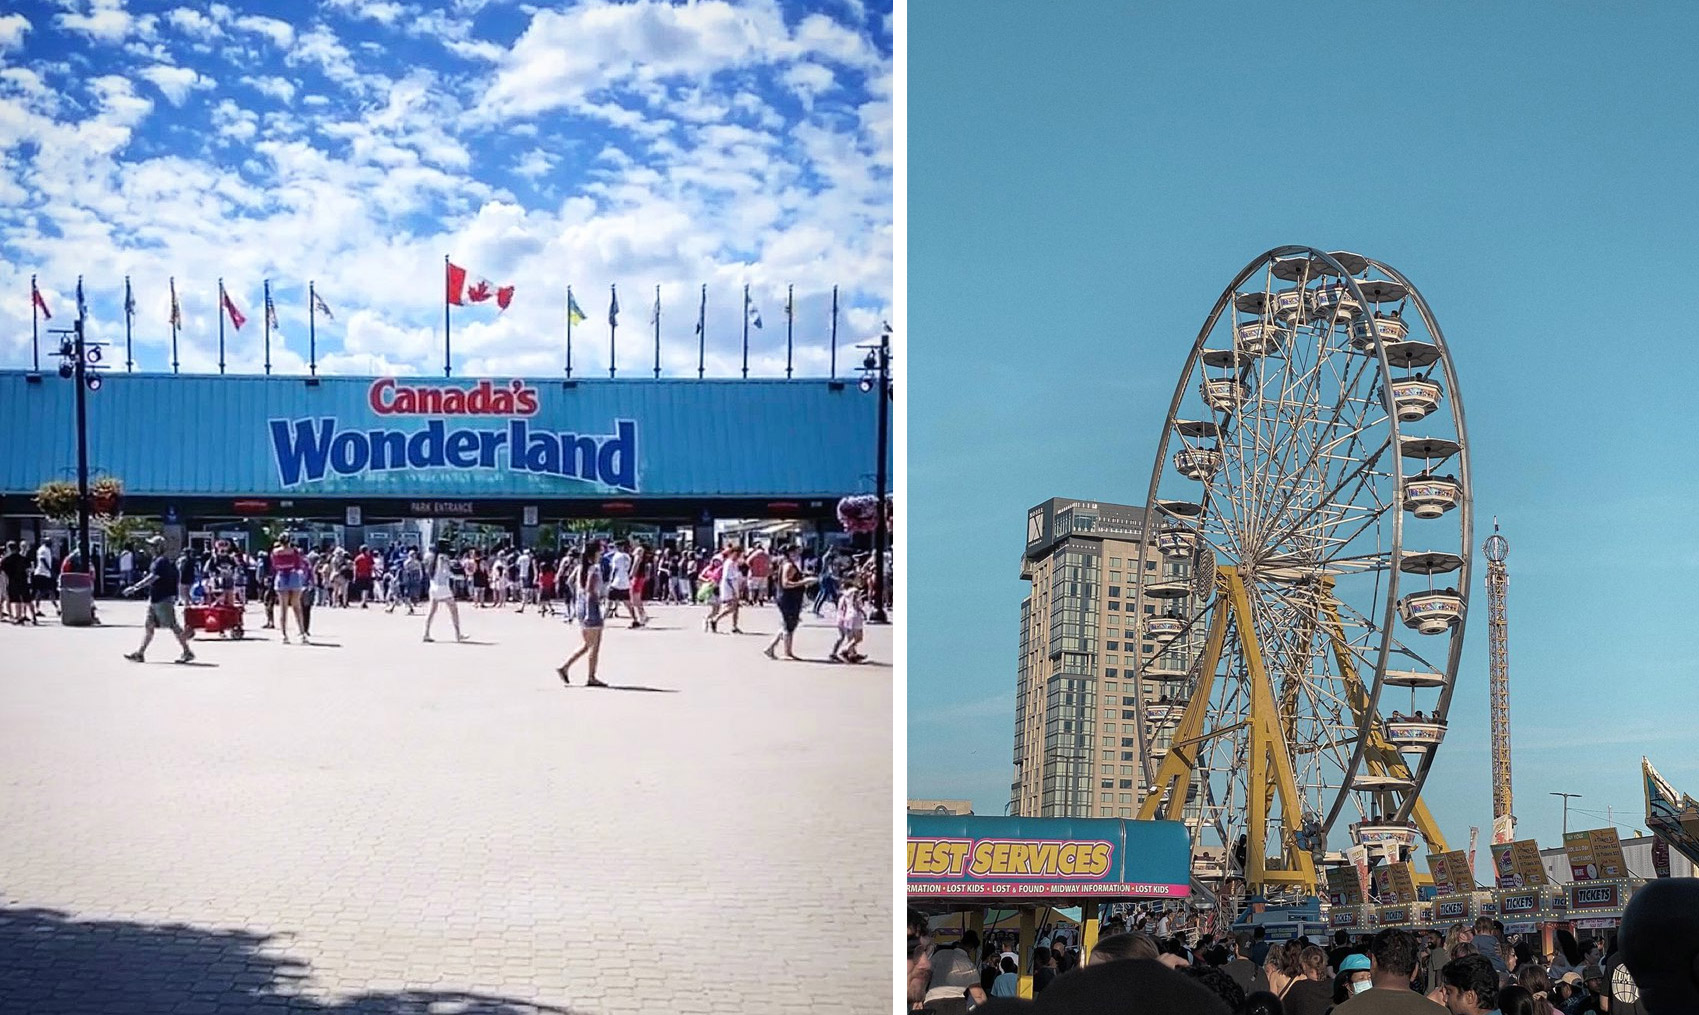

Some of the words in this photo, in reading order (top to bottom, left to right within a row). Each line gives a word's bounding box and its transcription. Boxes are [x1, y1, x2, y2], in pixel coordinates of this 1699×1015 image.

[369, 378, 539, 416] Canada's
[268, 417, 640, 492] Wonderland
[411, 502, 430, 512] PARK
[434, 502, 473, 512] ENTRANCE
[970, 841, 1111, 876] SERVICES
[947, 885, 966, 893] LOST
[967, 885, 984, 893] KIDS
[992, 885, 1010, 893] LOST
[1018, 885, 1044, 893] FOUND
[1051, 885, 1080, 893] MIDWAY
[1081, 885, 1130, 893] INFORMATION
[1136, 885, 1152, 893] LOST
[1153, 885, 1169, 893] KIDS
[1579, 888, 1610, 902] TICKETS
[1440, 902, 1463, 915] TICKETS
[1506, 896, 1533, 909] TICKETS
